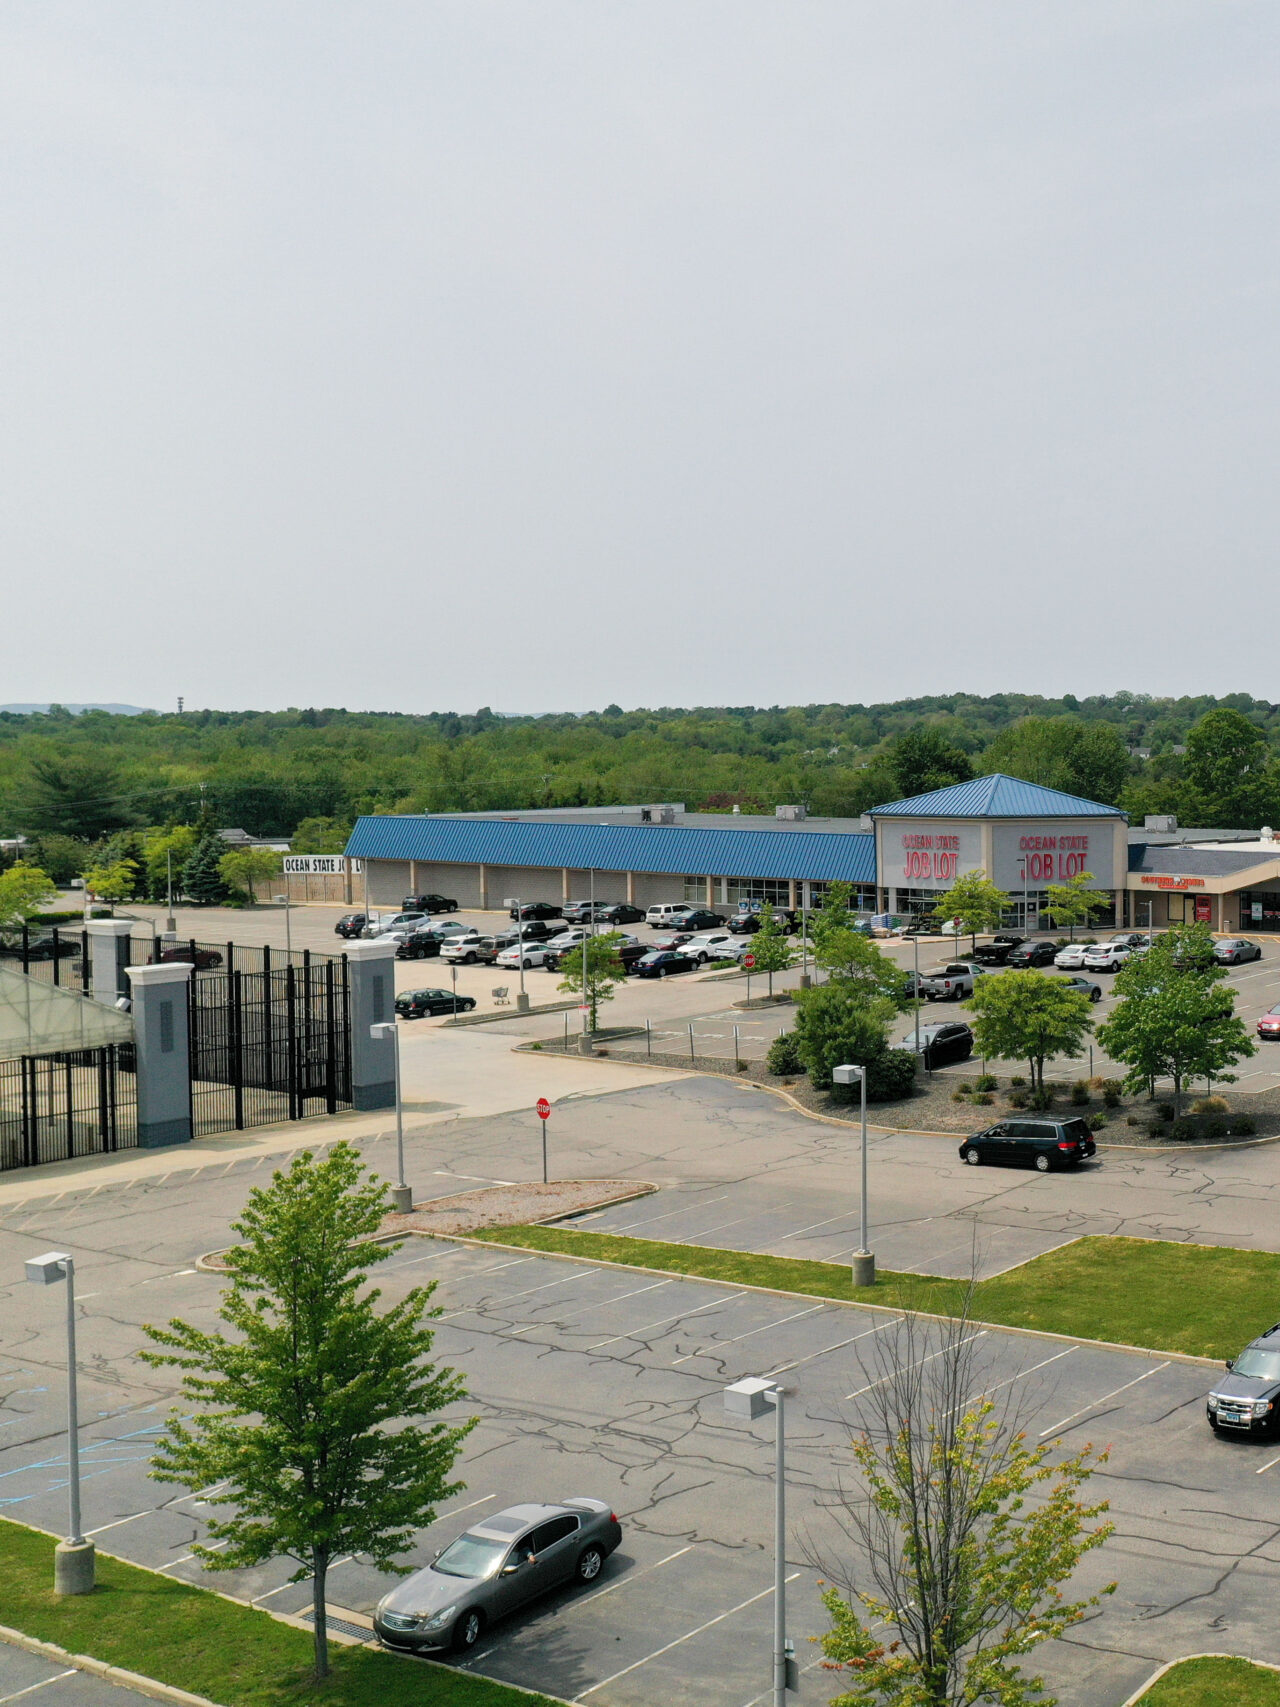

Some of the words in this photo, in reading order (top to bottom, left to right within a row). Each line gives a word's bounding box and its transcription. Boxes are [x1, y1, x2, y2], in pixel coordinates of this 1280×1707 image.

[902, 834, 933, 849] OCEAN
[935, 835, 960, 850] STATE
[1020, 836, 1057, 850] OCEAN
[1059, 836, 1089, 850] STATE
[285, 858, 310, 872] OCEAN
[312, 858, 335, 872] STATE
[904, 851, 931, 879] JOB
[933, 852, 959, 880] LOT
[1020, 853, 1054, 880] JOB
[1058, 852, 1088, 880] LOT
[537, 1104, 550, 1113] STOP
